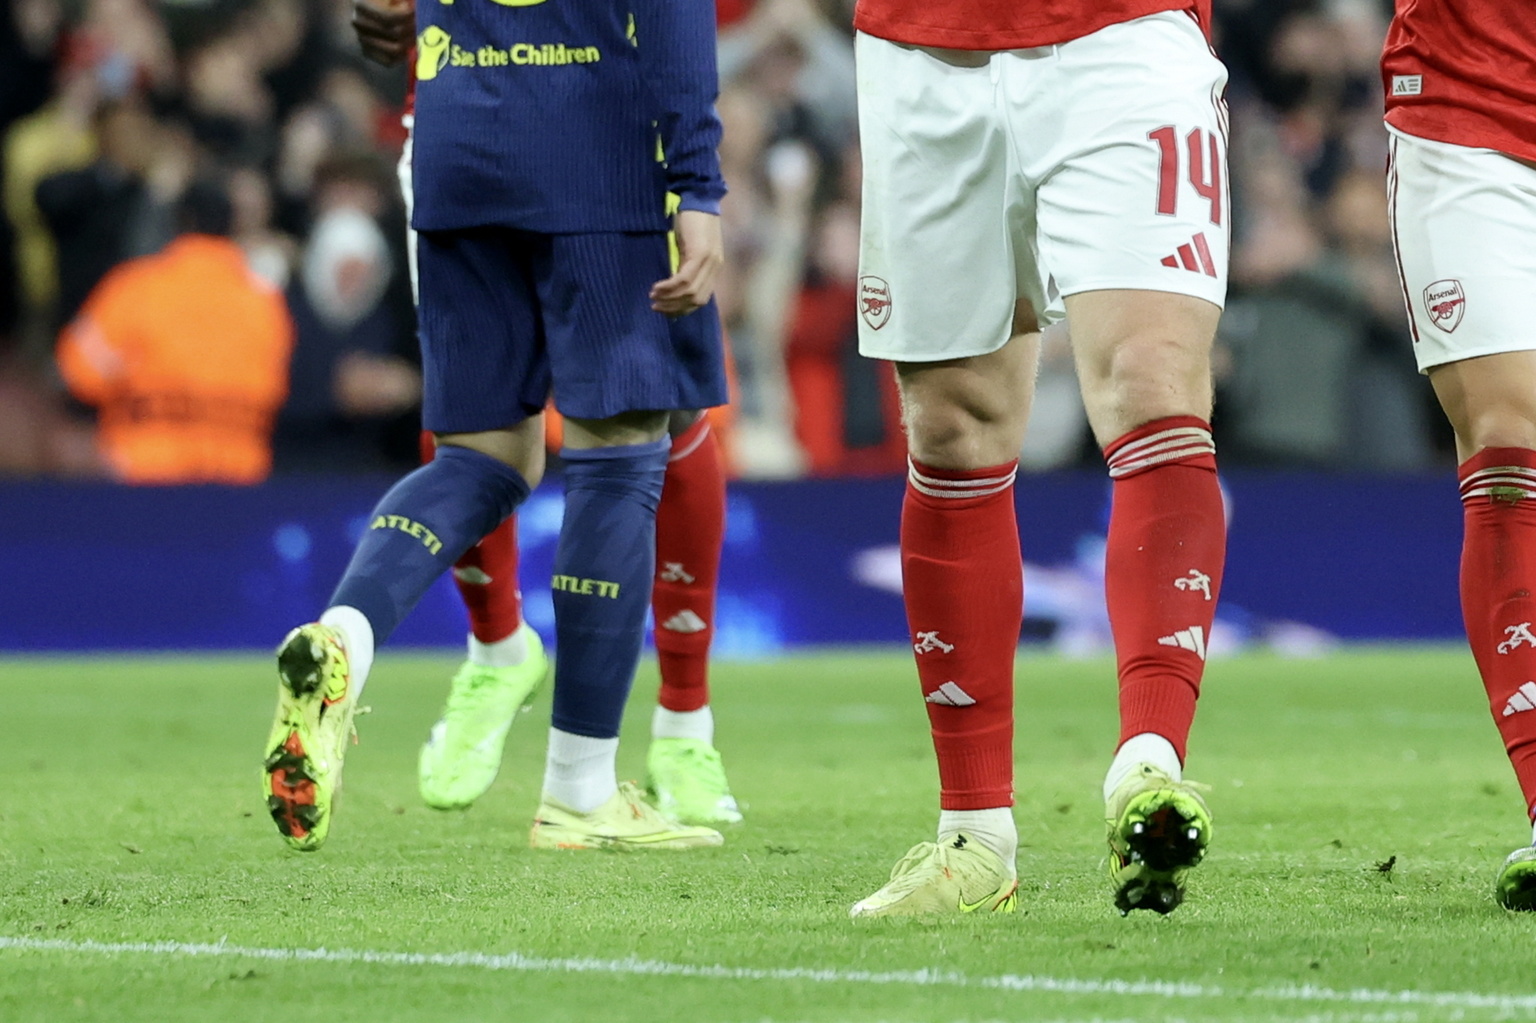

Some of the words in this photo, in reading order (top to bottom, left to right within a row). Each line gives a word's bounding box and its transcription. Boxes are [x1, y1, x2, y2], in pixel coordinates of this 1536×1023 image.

[477, 45, 509, 67] the
[510, 43, 600, 66] Children
[1146, 125, 1221, 227] 14
[1428, 286, 1457, 302] Arsenal
[369, 514, 443, 556] ATLETI
